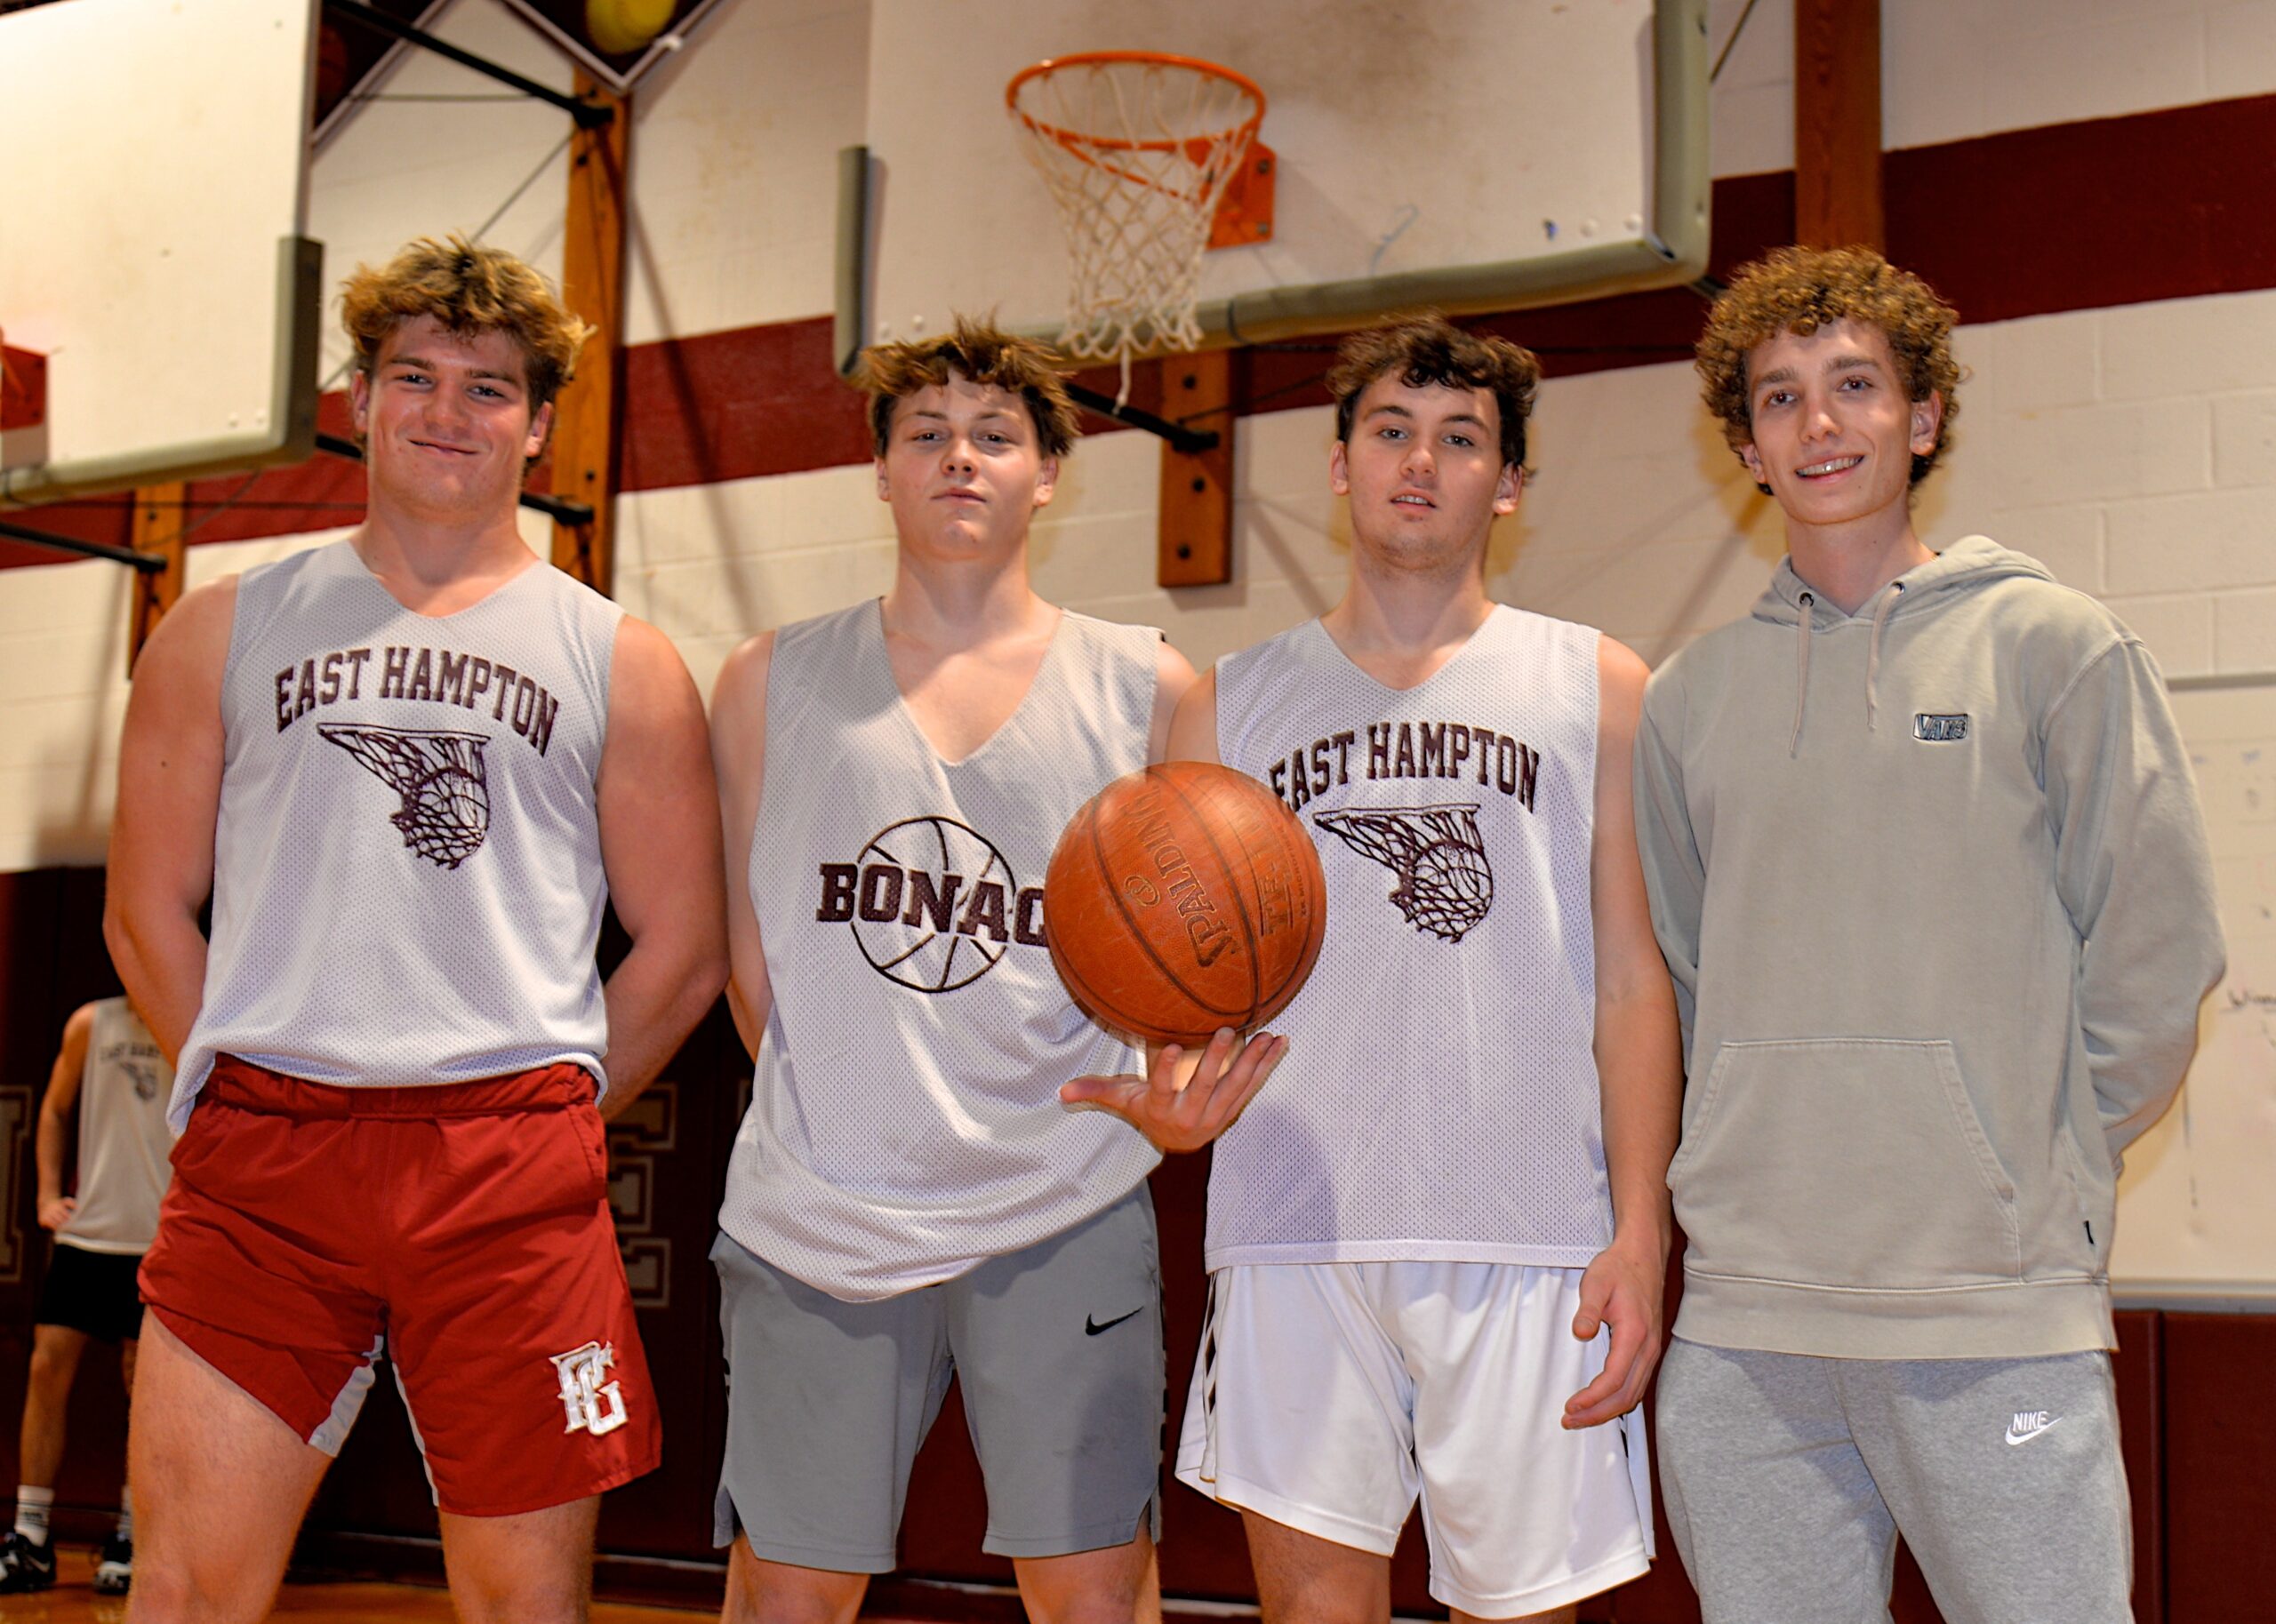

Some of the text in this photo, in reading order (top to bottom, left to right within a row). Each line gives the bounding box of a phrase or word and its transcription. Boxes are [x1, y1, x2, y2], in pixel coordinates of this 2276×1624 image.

[274, 646, 559, 757] EAST HAMPTON
[1269, 721, 1539, 813] EAST HAMPTON
[816, 862, 1050, 948] BONAC
[1118, 788, 1240, 967] SPALDING
[2013, 1411, 2049, 1431] NIKE
